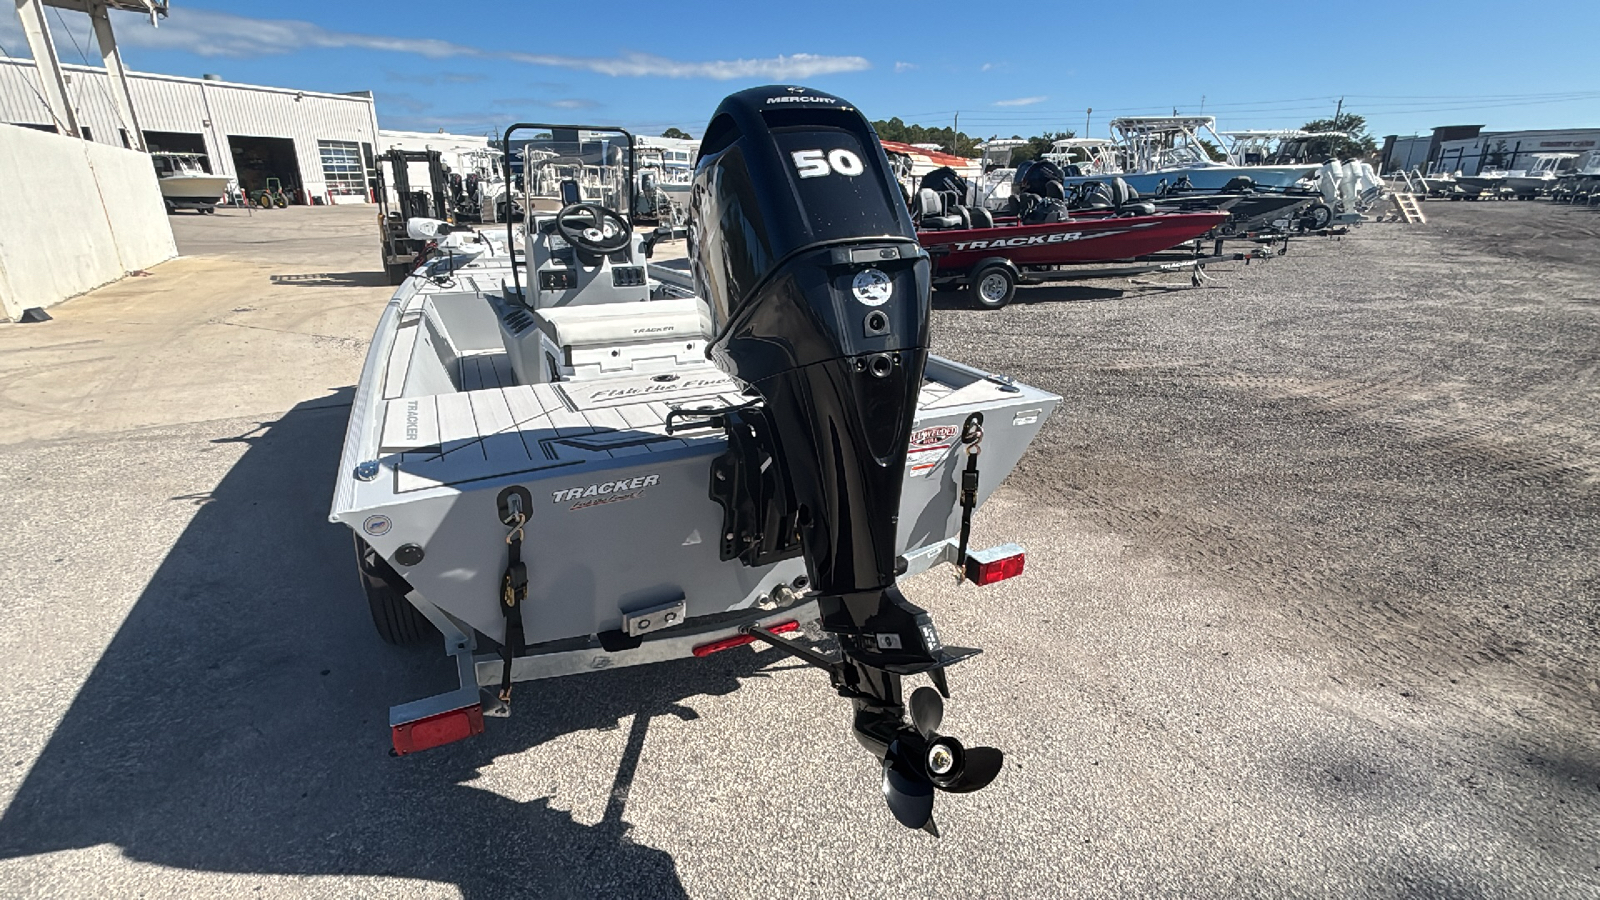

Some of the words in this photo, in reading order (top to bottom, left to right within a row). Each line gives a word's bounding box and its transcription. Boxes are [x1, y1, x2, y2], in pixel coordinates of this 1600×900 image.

[766, 96, 836, 104] MERCURY
[791, 148, 864, 179] 50
[954, 231, 1082, 251] TRACKER
[633, 325, 675, 334] TRACKER
[406, 400, 418, 441] TRACKER
[552, 473, 661, 503] TRACKER
